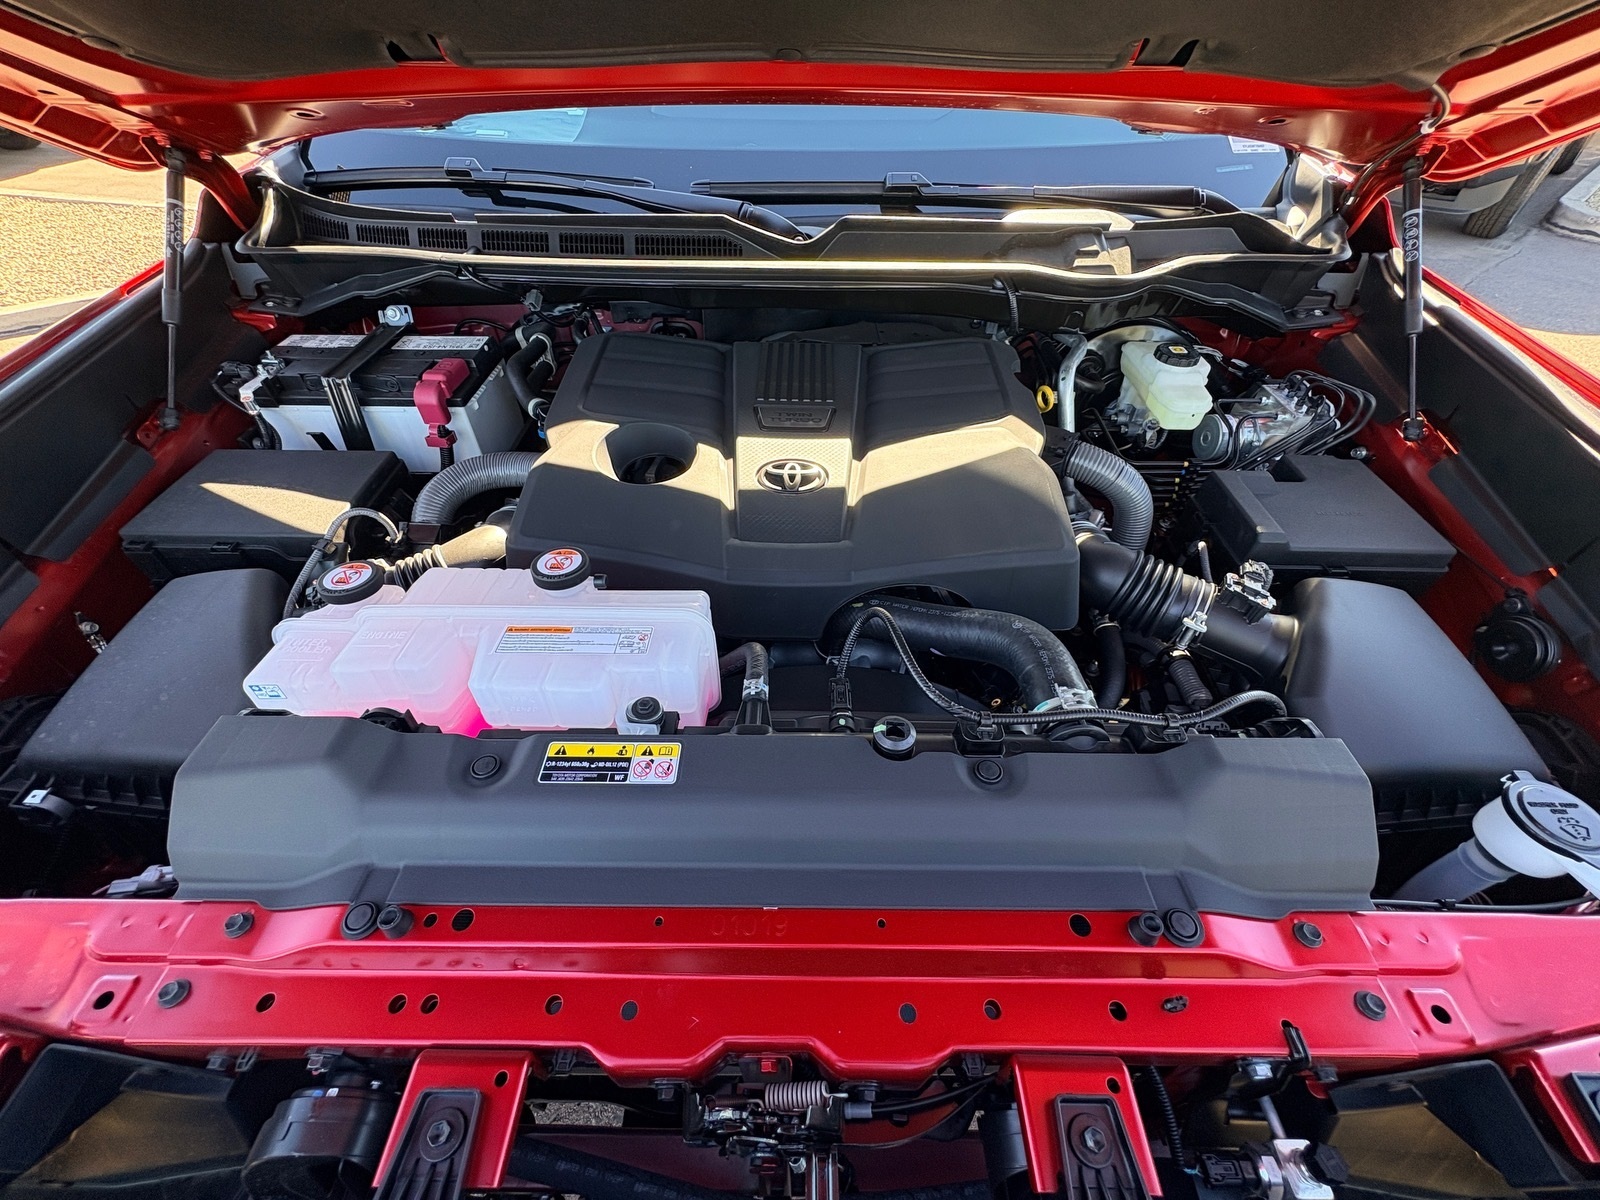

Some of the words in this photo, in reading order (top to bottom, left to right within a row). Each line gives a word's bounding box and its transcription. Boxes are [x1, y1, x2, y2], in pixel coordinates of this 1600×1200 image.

[361, 631, 408, 640] ENGINE
[288, 638, 329, 647] INTER
[1029, 634, 1042, 647] WATER
[282, 645, 332, 654] COOLER
